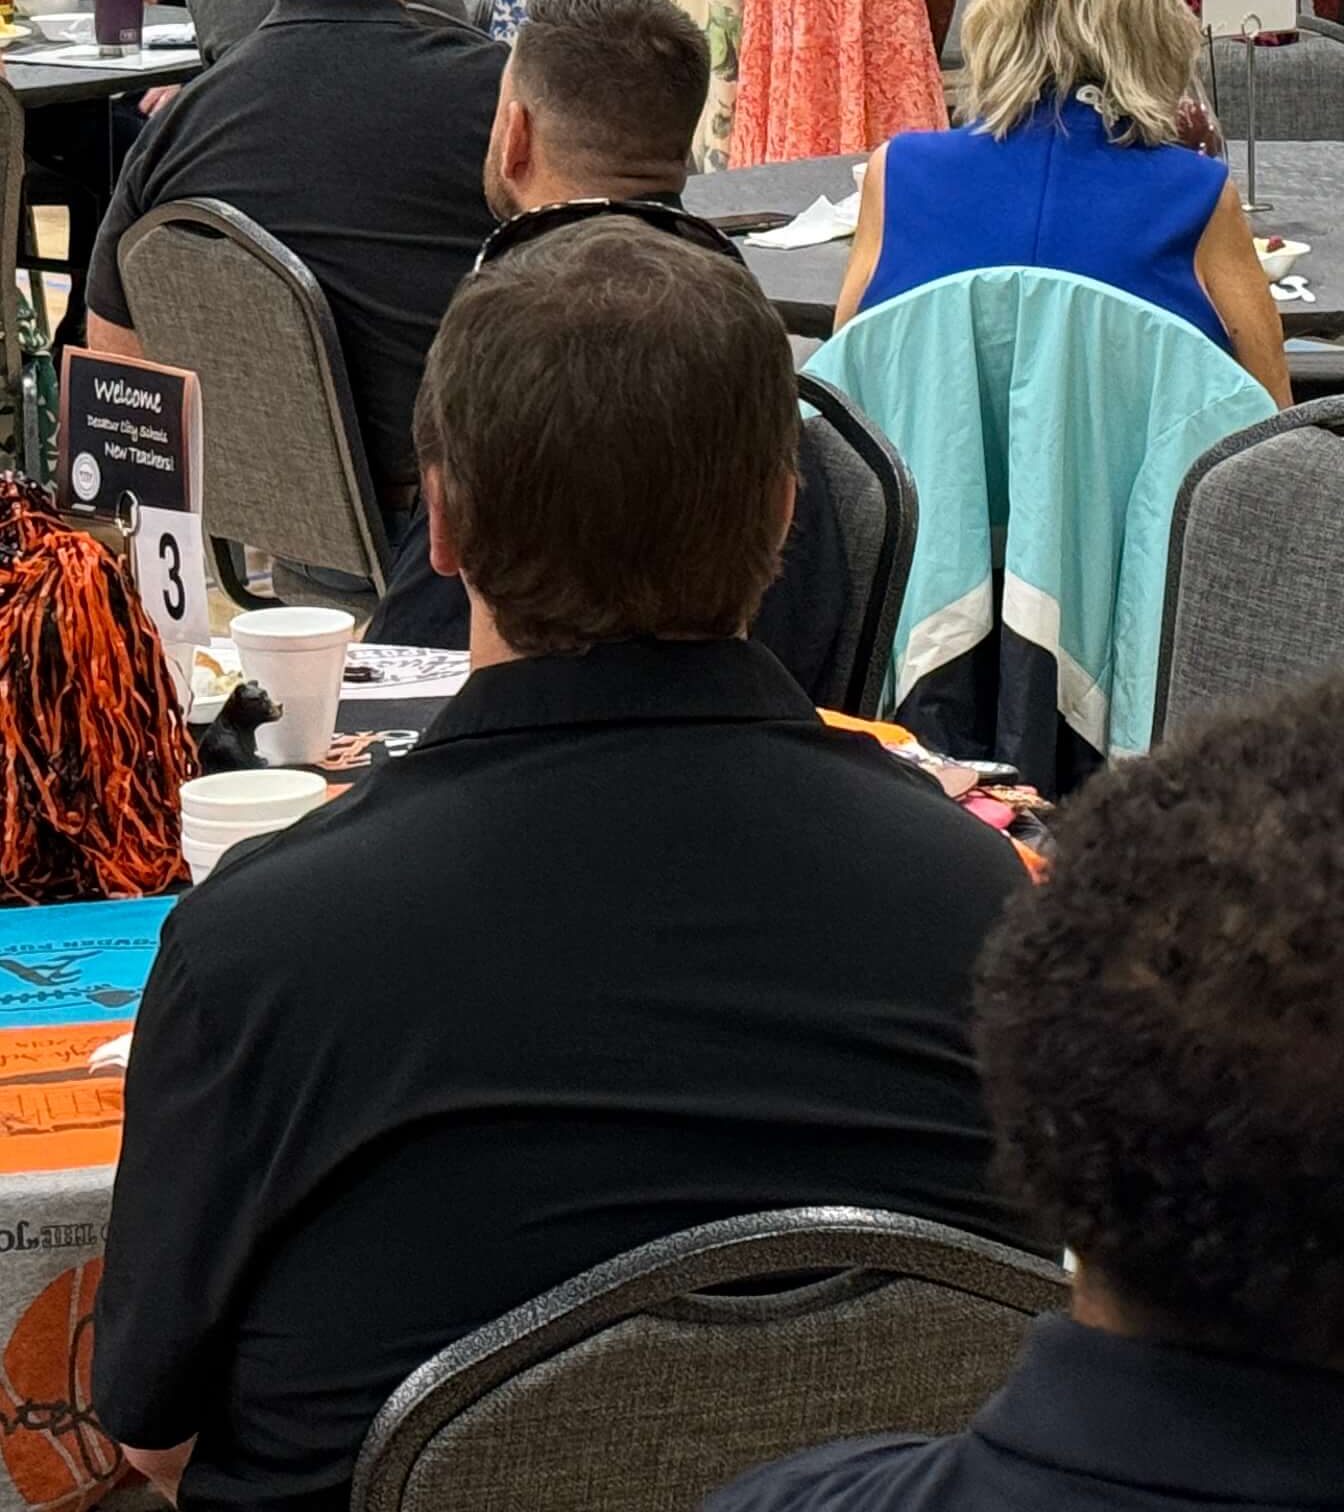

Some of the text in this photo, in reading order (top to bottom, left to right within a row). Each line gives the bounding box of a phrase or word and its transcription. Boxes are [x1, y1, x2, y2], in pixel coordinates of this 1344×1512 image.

[94, 376, 162, 414] Welcome
[86, 414, 169, 444] Decatur City Schools
[104, 440, 175, 472] New Teachers!
[159, 532, 186, 622] 3
